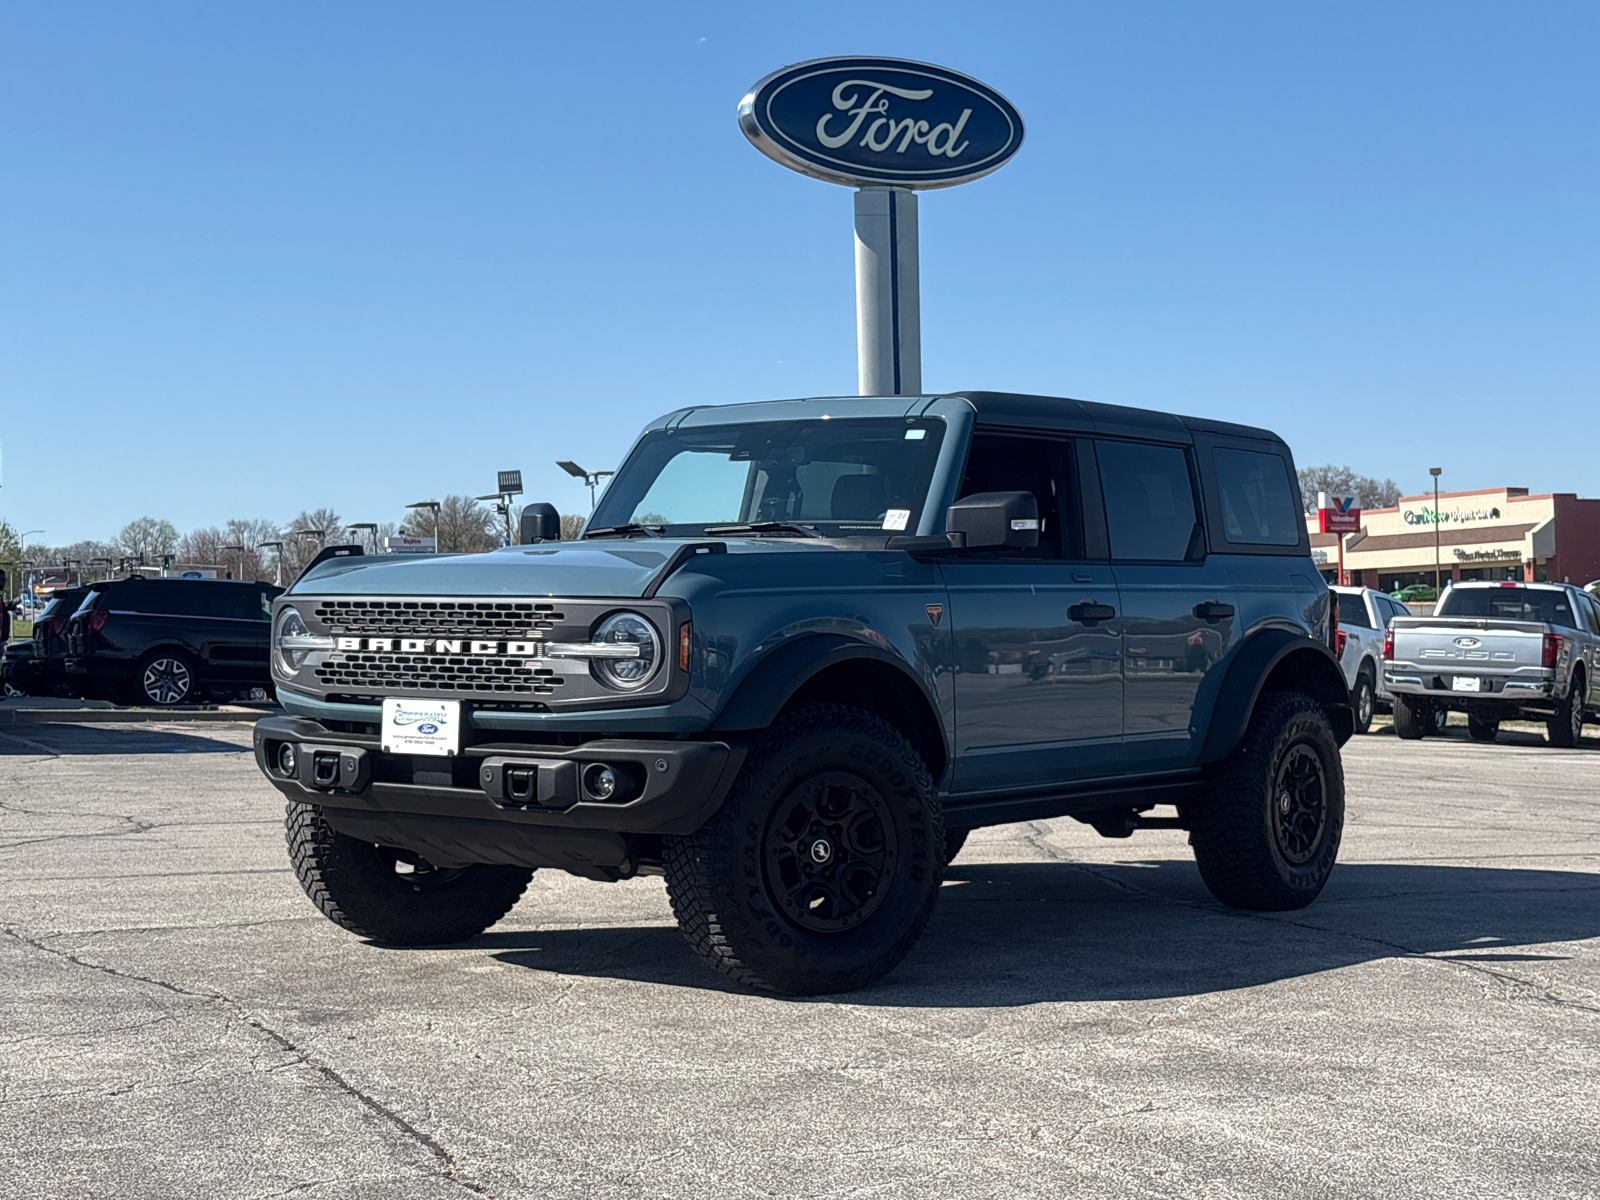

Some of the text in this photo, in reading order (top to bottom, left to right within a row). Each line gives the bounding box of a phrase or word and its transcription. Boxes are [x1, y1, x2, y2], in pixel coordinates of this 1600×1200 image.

[815, 79, 973, 158] Ford
[337, 637, 537, 655] BRONCO
[1419, 648, 1516, 661] F-150
[847, 743, 927, 883] GOODYEAR
